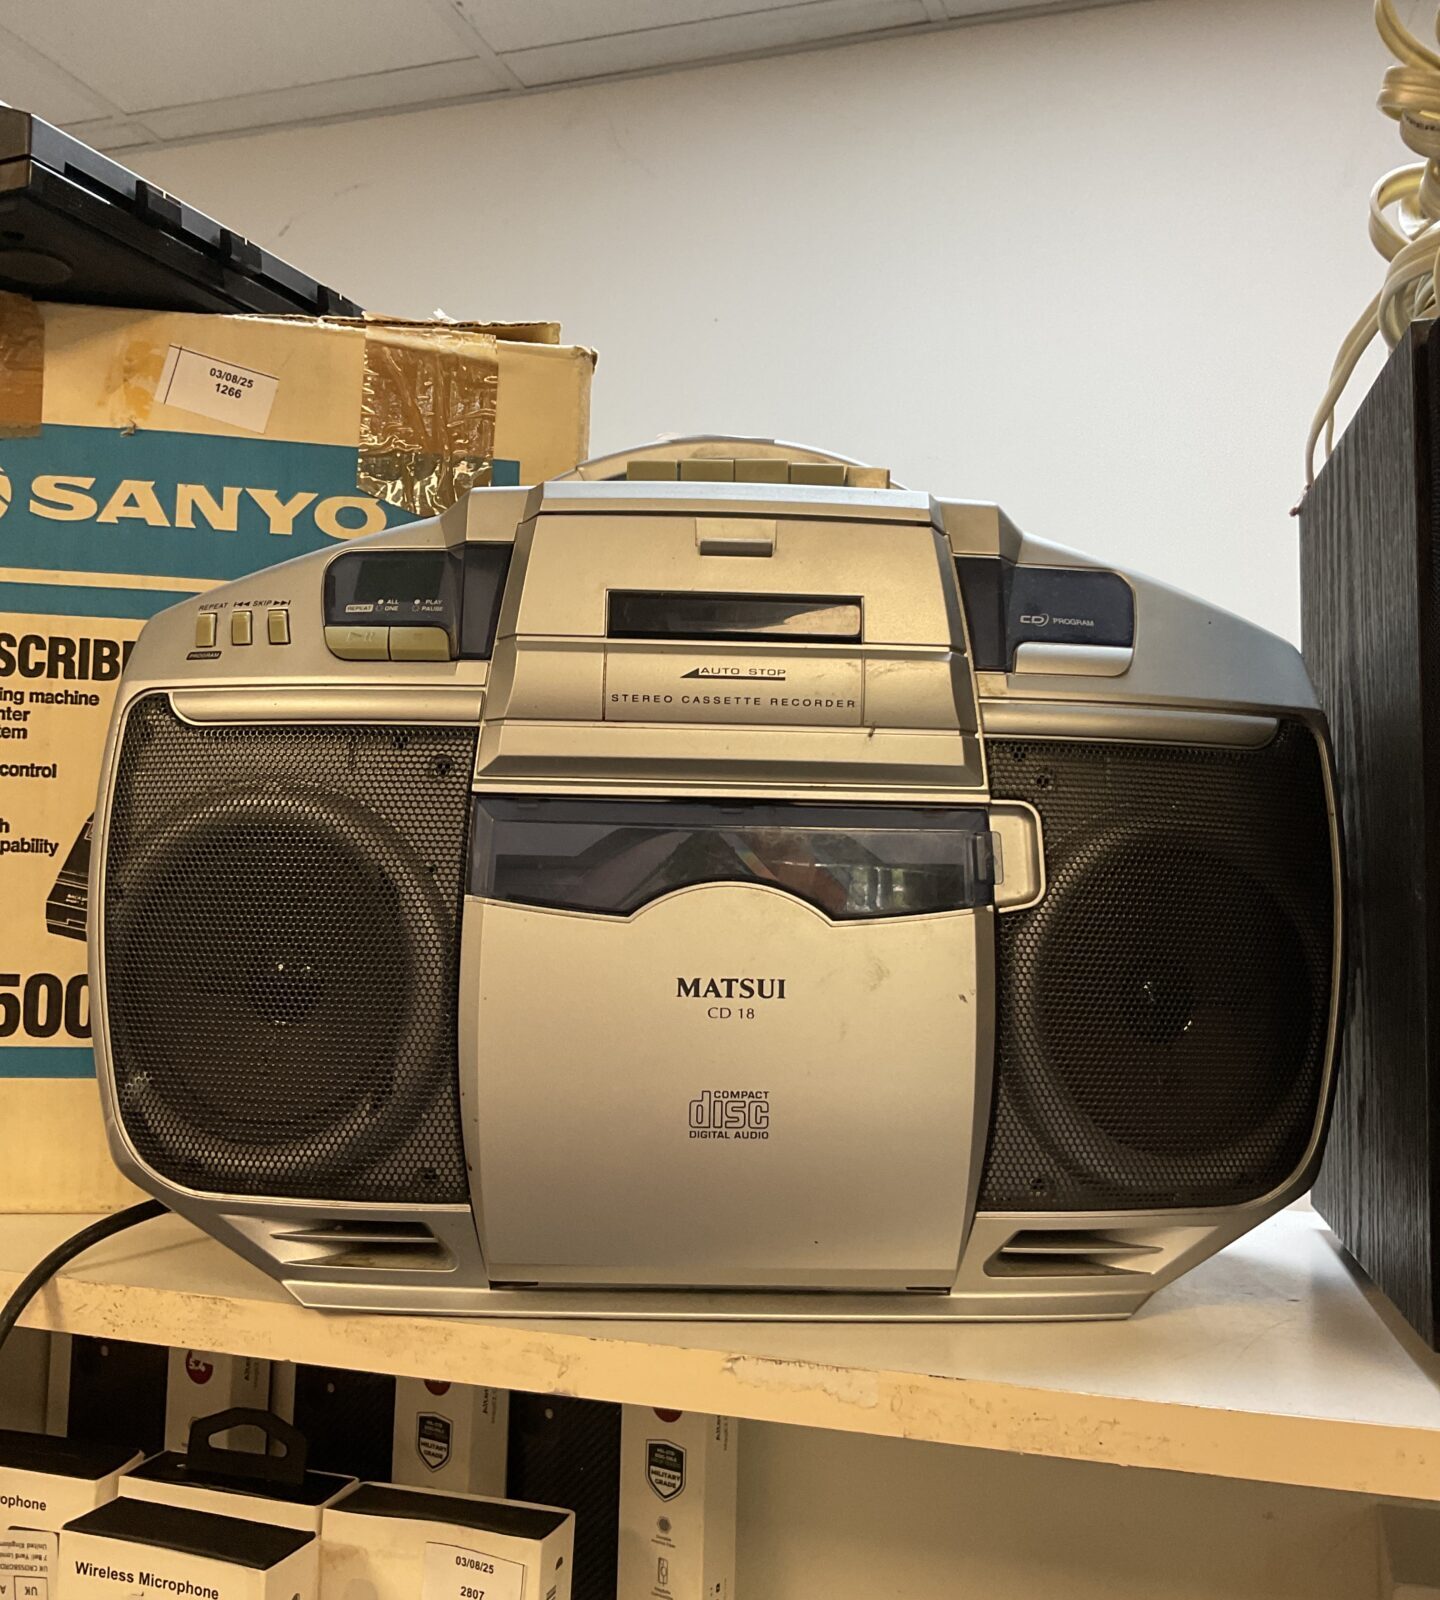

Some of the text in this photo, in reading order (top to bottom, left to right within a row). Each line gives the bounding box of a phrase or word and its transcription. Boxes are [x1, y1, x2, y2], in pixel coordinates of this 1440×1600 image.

[209, 367, 254, 389] 03/08/25
[215, 382, 242, 399] 1266
[28, 474, 388, 541] SANYO
[198, 599, 273, 612] REPEAT SKIP
[1019, 613, 1095, 627] CD PROGRAM
[700, 667, 787, 677] AUTO STOP
[29, 690, 100, 706] machine
[611, 694, 856, 708] STEREO CASSETTE RECORDER
[0, 763, 58, 779] control
[676, 977, 787, 999] MATSUI
[707, 1007, 756, 1019] CD 18
[713, 1090, 770, 1100] COMPACT
[689, 1130, 769, 1140] DIGITAL AUDIO
[650, 1469, 681, 1482] MILITARY
[654, 1478, 677, 1489] GRADE
[0, 1494, 47, 1512] ophone
[455, 1555, 495, 1575] 03/08/25
[75, 1560, 219, 1600] Wireless Microphone
[24, 1585, 38, 1597] UK
[460, 1585, 485, 1600] 2807
